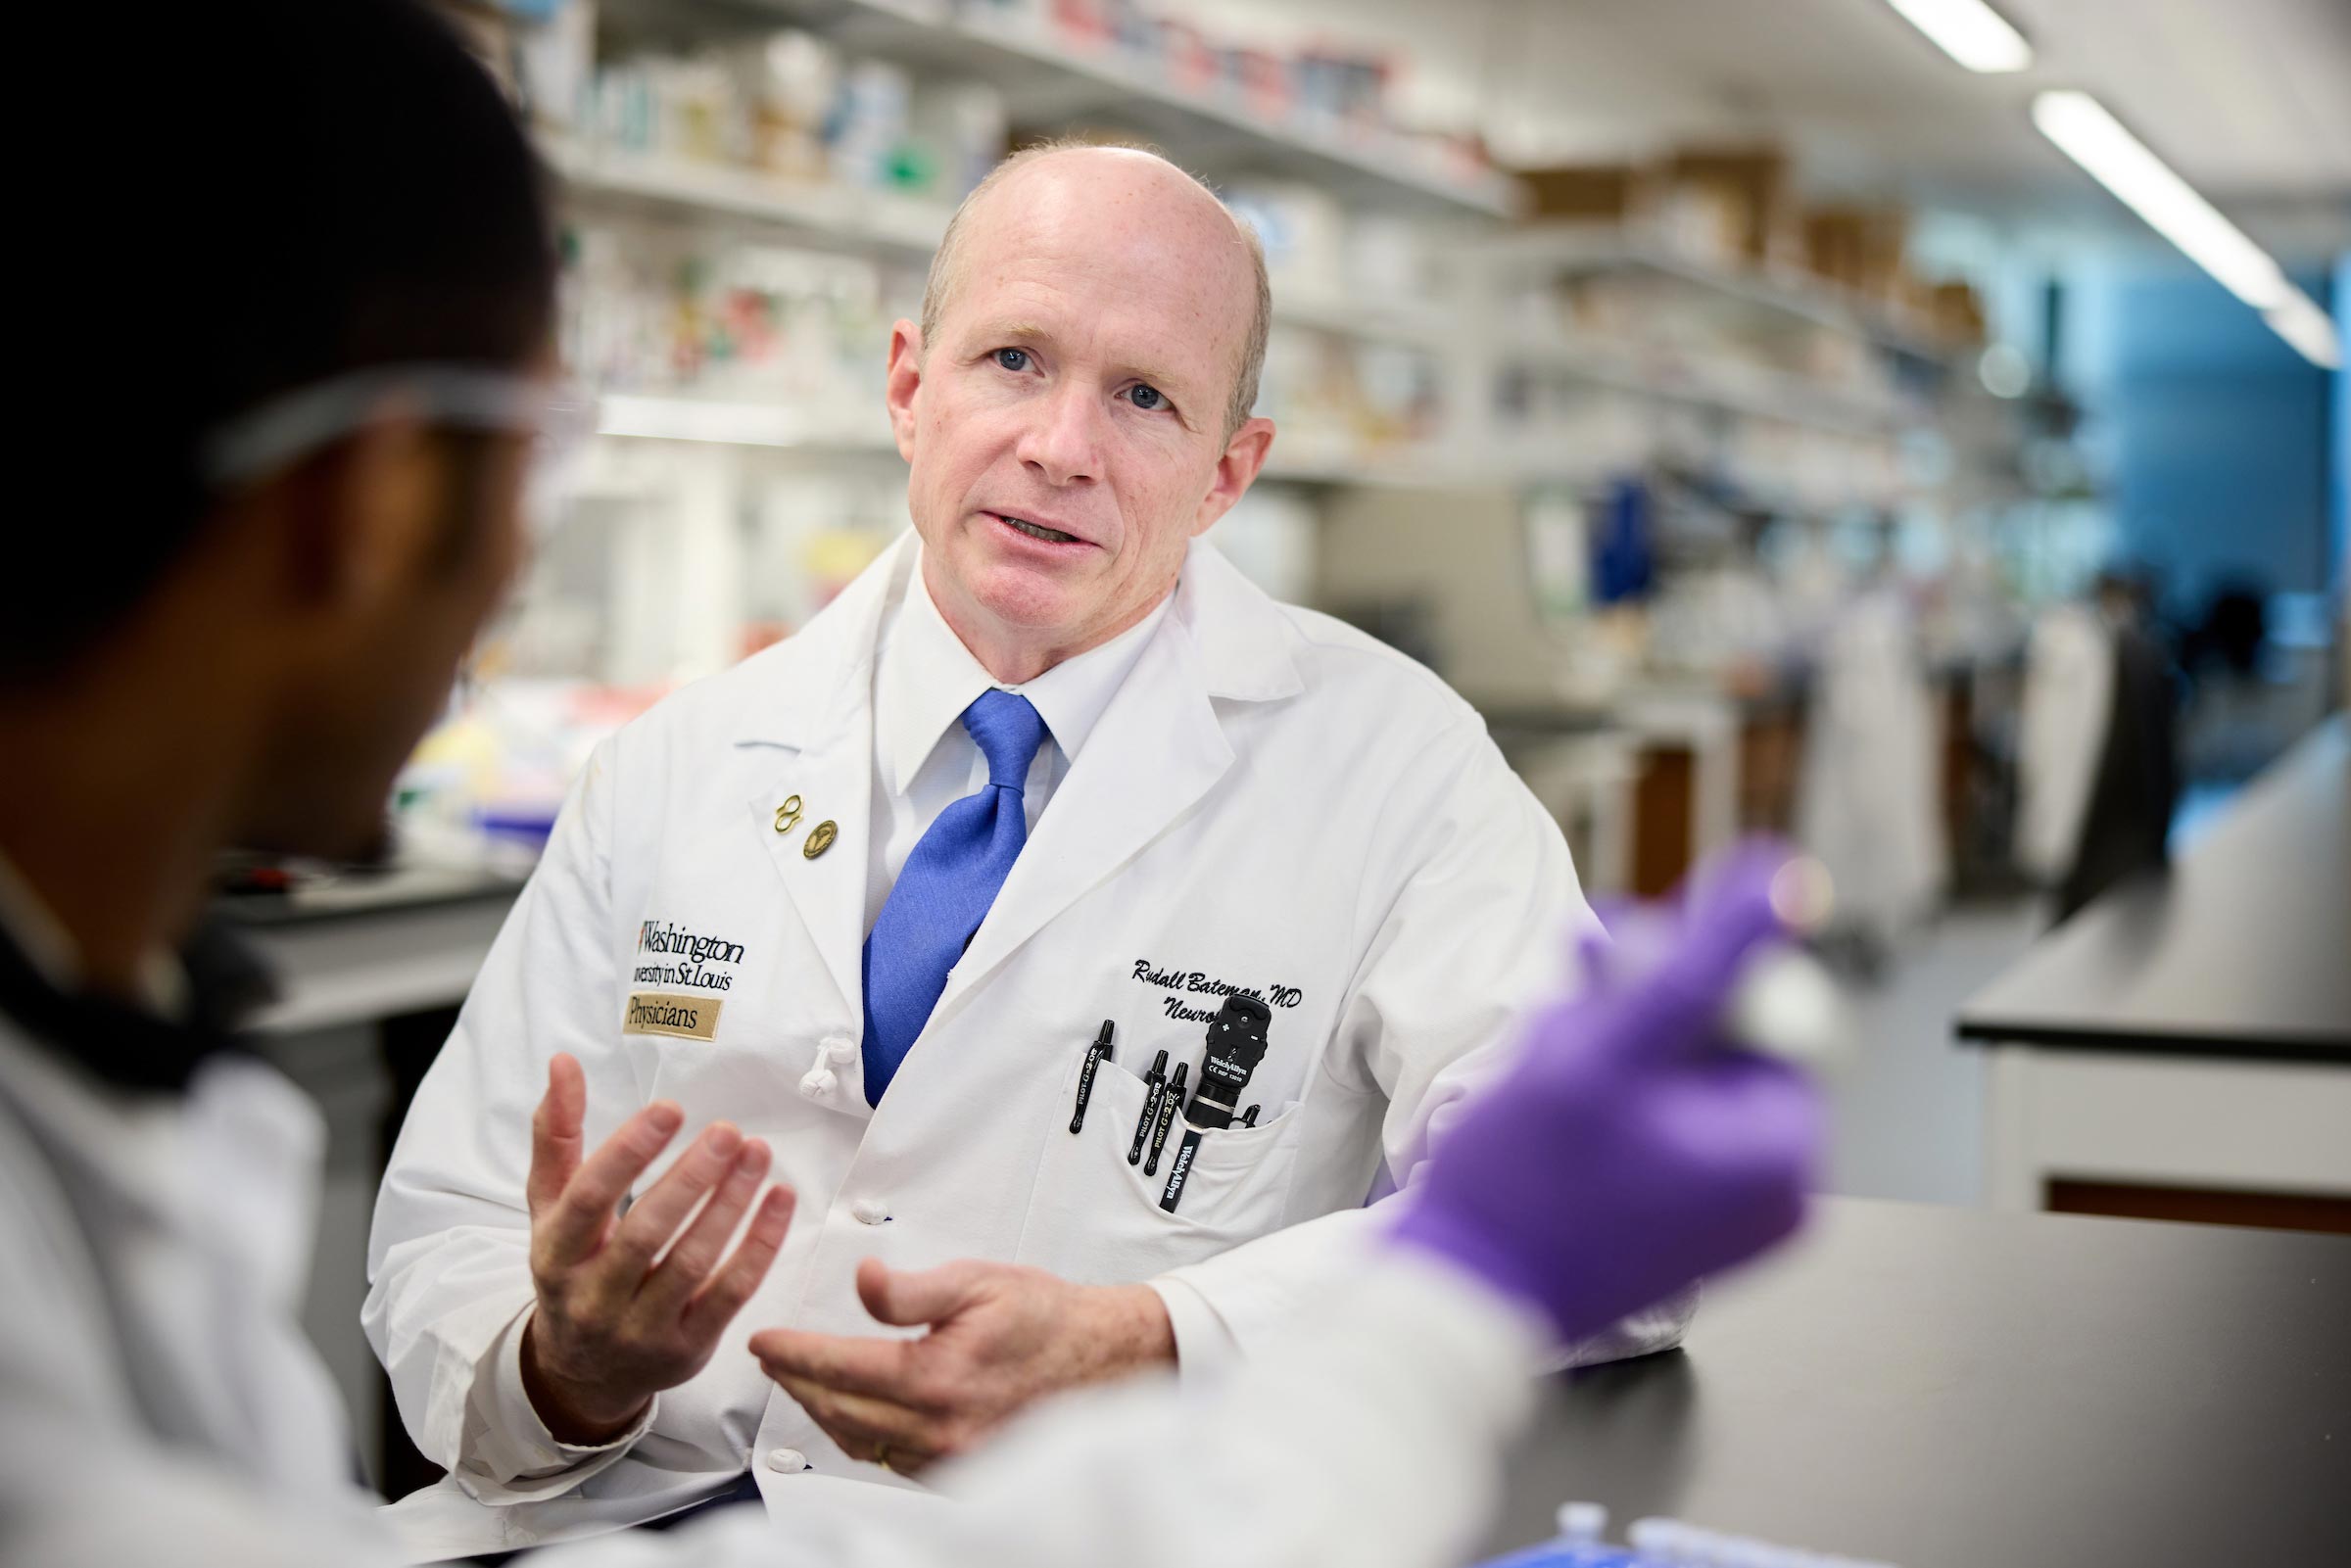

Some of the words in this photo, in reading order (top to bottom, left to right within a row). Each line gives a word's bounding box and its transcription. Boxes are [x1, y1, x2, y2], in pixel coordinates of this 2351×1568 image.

[644, 920, 744, 965] Washington
[663, 963, 675, 983] in
[692, 964, 733, 991] Louis
[1270, 983, 1303, 1009] MD
[628, 996, 698, 1030] Physicians
[1082, 1061, 1093, 1082] G-2
[1078, 1082, 1087, 1105] PILOT
[1139, 1116, 1151, 1138] PILOT
[1146, 1096, 1158, 1116] G-2
[1154, 1126, 1166, 1149] PILOT
[1161, 1106, 1173, 1126] G-2
